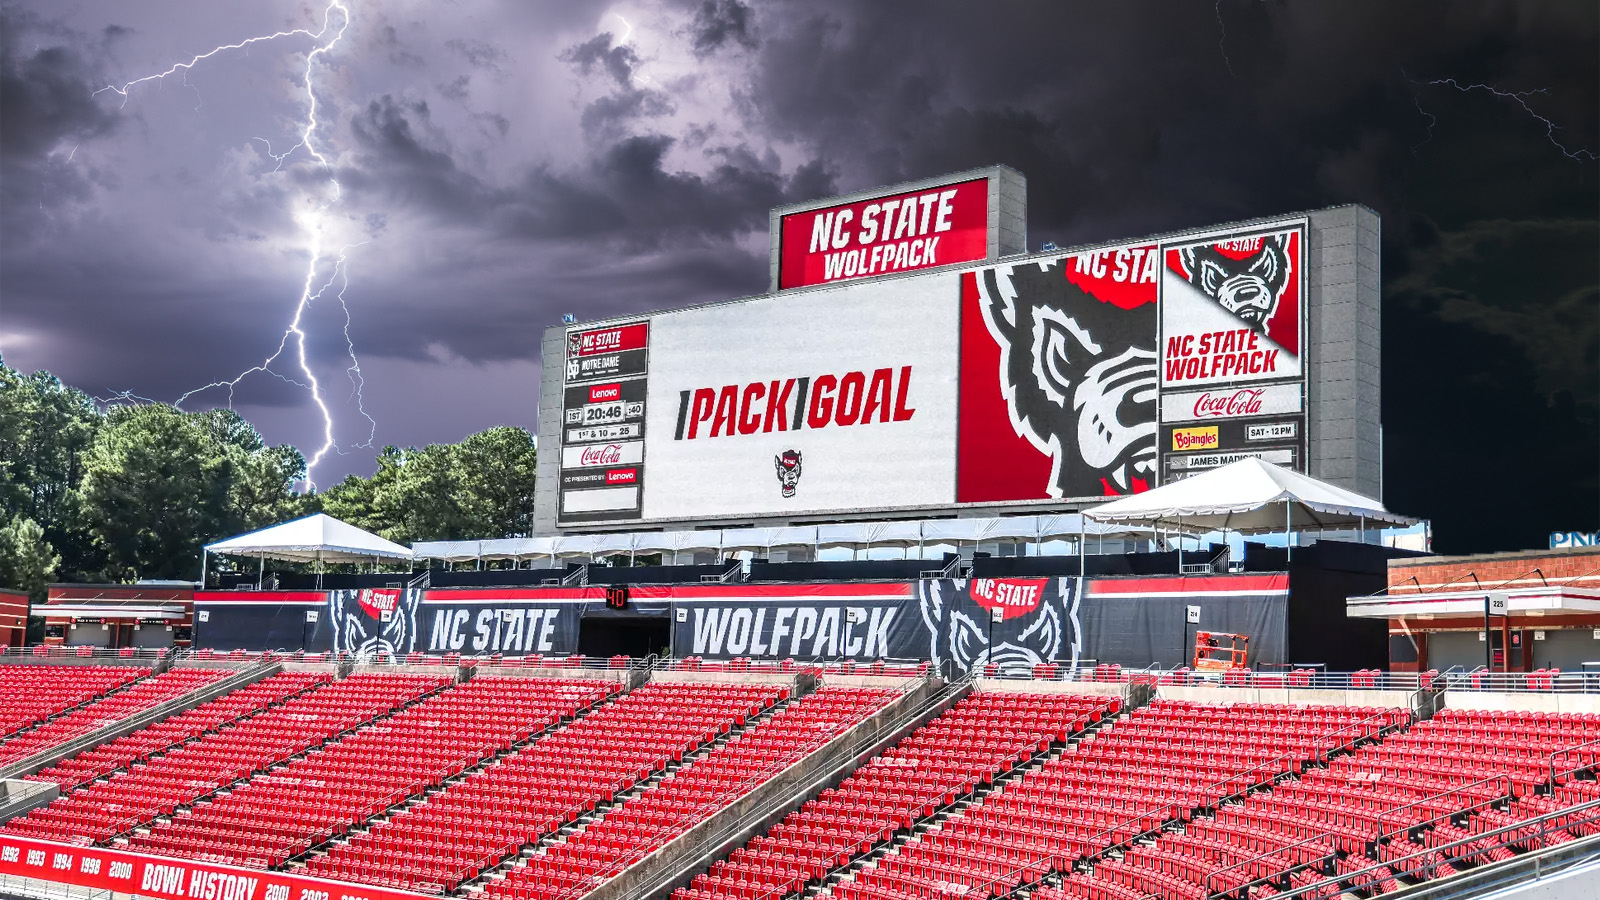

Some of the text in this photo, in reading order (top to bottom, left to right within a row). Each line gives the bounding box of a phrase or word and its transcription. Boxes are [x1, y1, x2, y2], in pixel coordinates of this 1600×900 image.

[809, 189, 958, 253] NC STATE
[1232, 238, 1260, 251] STATE
[824, 236, 940, 279] WOLFPACK
[1075, 247, 1110, 279] NC
[582, 331, 622, 348] NC STATE
[1166, 329, 1259, 358] NC STATE
[581, 356, 620, 371] NOTRE DAME
[1165, 349, 1280, 381] WOLFPACK
[591, 388, 618, 398] Lenovo
[1193, 388, 1266, 418] Coca-Cola
[569, 411, 580, 420] 1ST
[587, 406, 621, 420] 20:46
[599, 429, 608, 437] 10
[619, 427, 630, 435] 25
[1174, 432, 1217, 448] Bojangles
[1250, 428, 1266, 437] SAT
[1271, 427, 1280, 435] 12
[1280, 426, 1292, 435] PM
[1189, 456, 1219, 466] JAMES
[608, 472, 634, 481] Lenovo
[362, 589, 396, 610] NC STATE
[607, 589, 624, 607] 40
[976, 578, 1038, 606] NC STATE
[430, 609, 561, 651] NC STATE
[692, 607, 898, 657] WOLFPACK
[1, 845, 20, 862] 1992
[26, 849, 46, 867] 1993
[52, 853, 73, 871] 1994
[80, 856, 101, 874] 1998
[108, 861, 133, 880] 2000
[141, 863, 185, 896] BOWL
[188, 869, 258, 900] HISTORY
[264, 883, 290, 900] 2001
